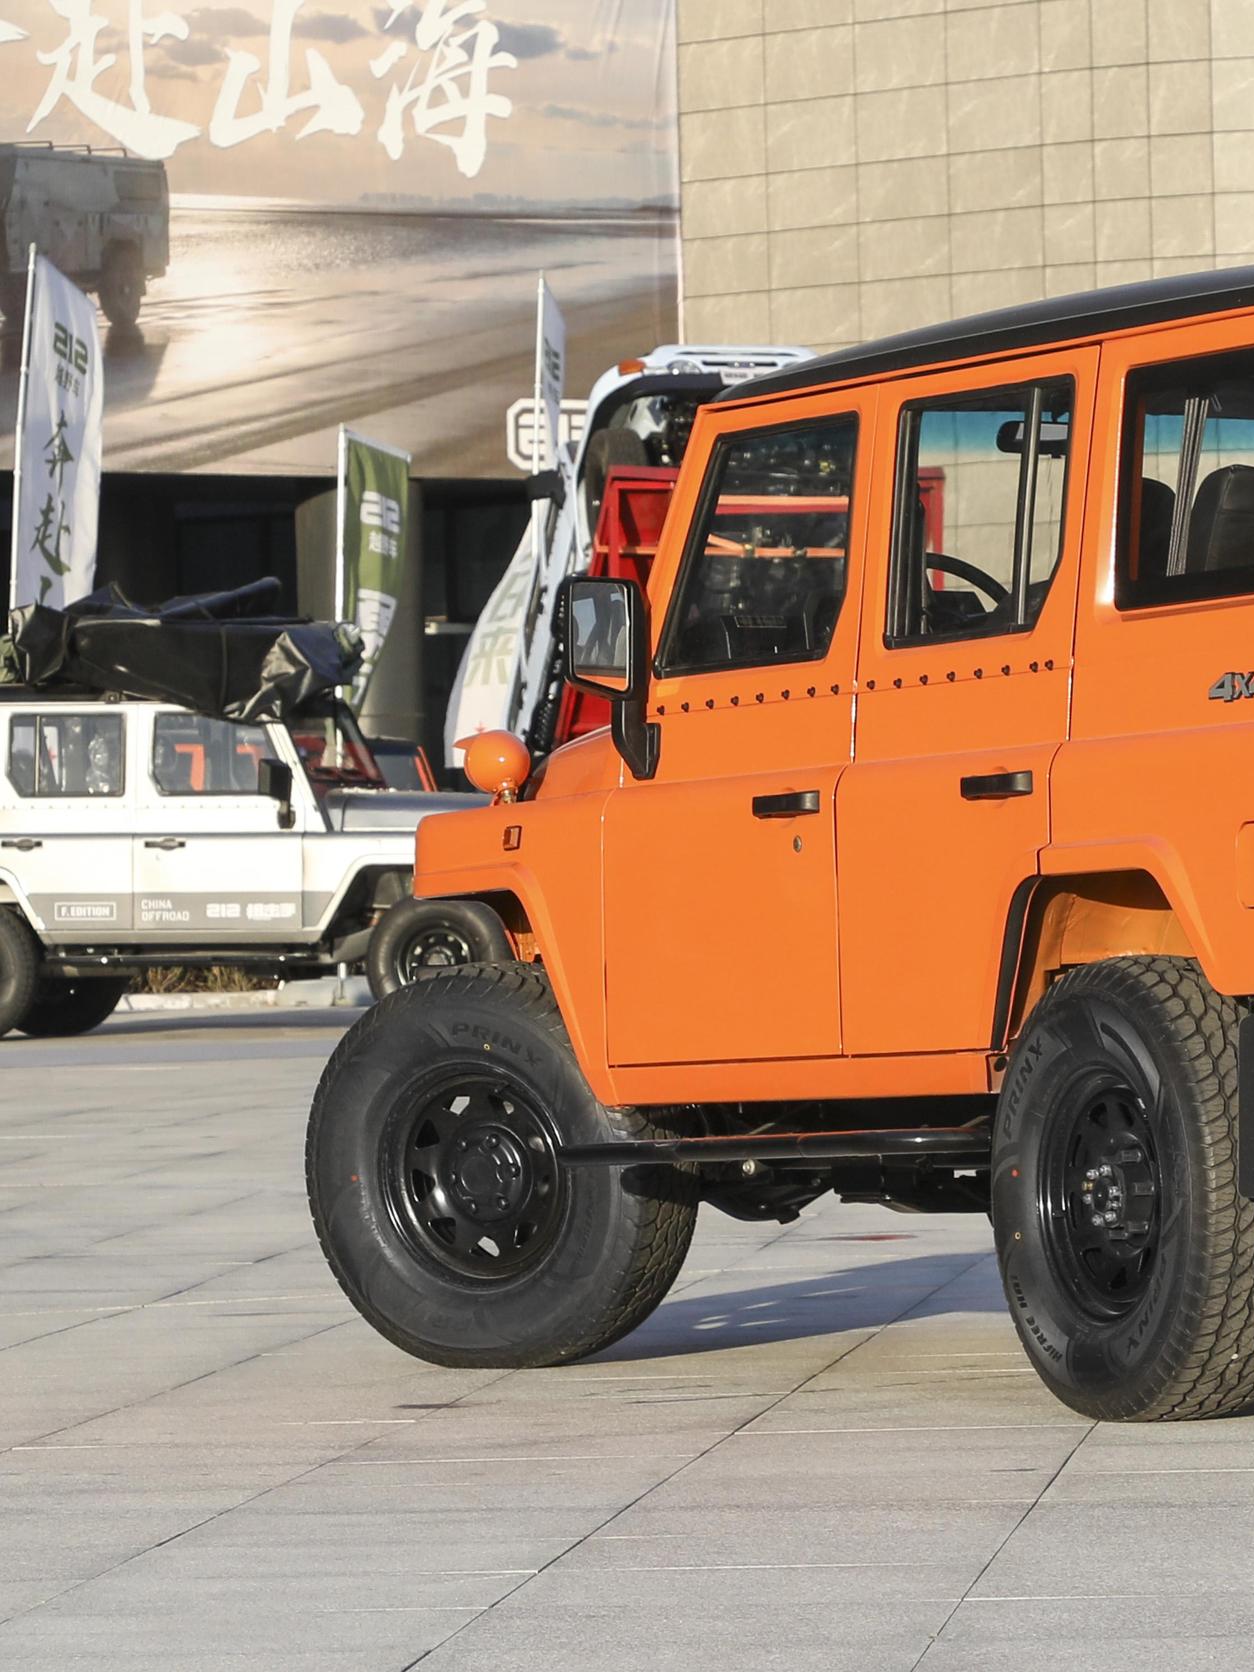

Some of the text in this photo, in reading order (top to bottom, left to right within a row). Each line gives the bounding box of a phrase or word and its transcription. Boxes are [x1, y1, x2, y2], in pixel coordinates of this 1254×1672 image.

[0, 0, 517, 178] 赴山海
[54, 321, 88, 375] 212
[29, 410, 74, 604] 奔赴
[141, 899, 172, 910] CHINA
[141, 911, 190, 922] OFFROAD
[206, 903, 240, 918] 212
[452, 1021, 542, 1067] PRINX
[1002, 1034, 1045, 1140] PRINX
